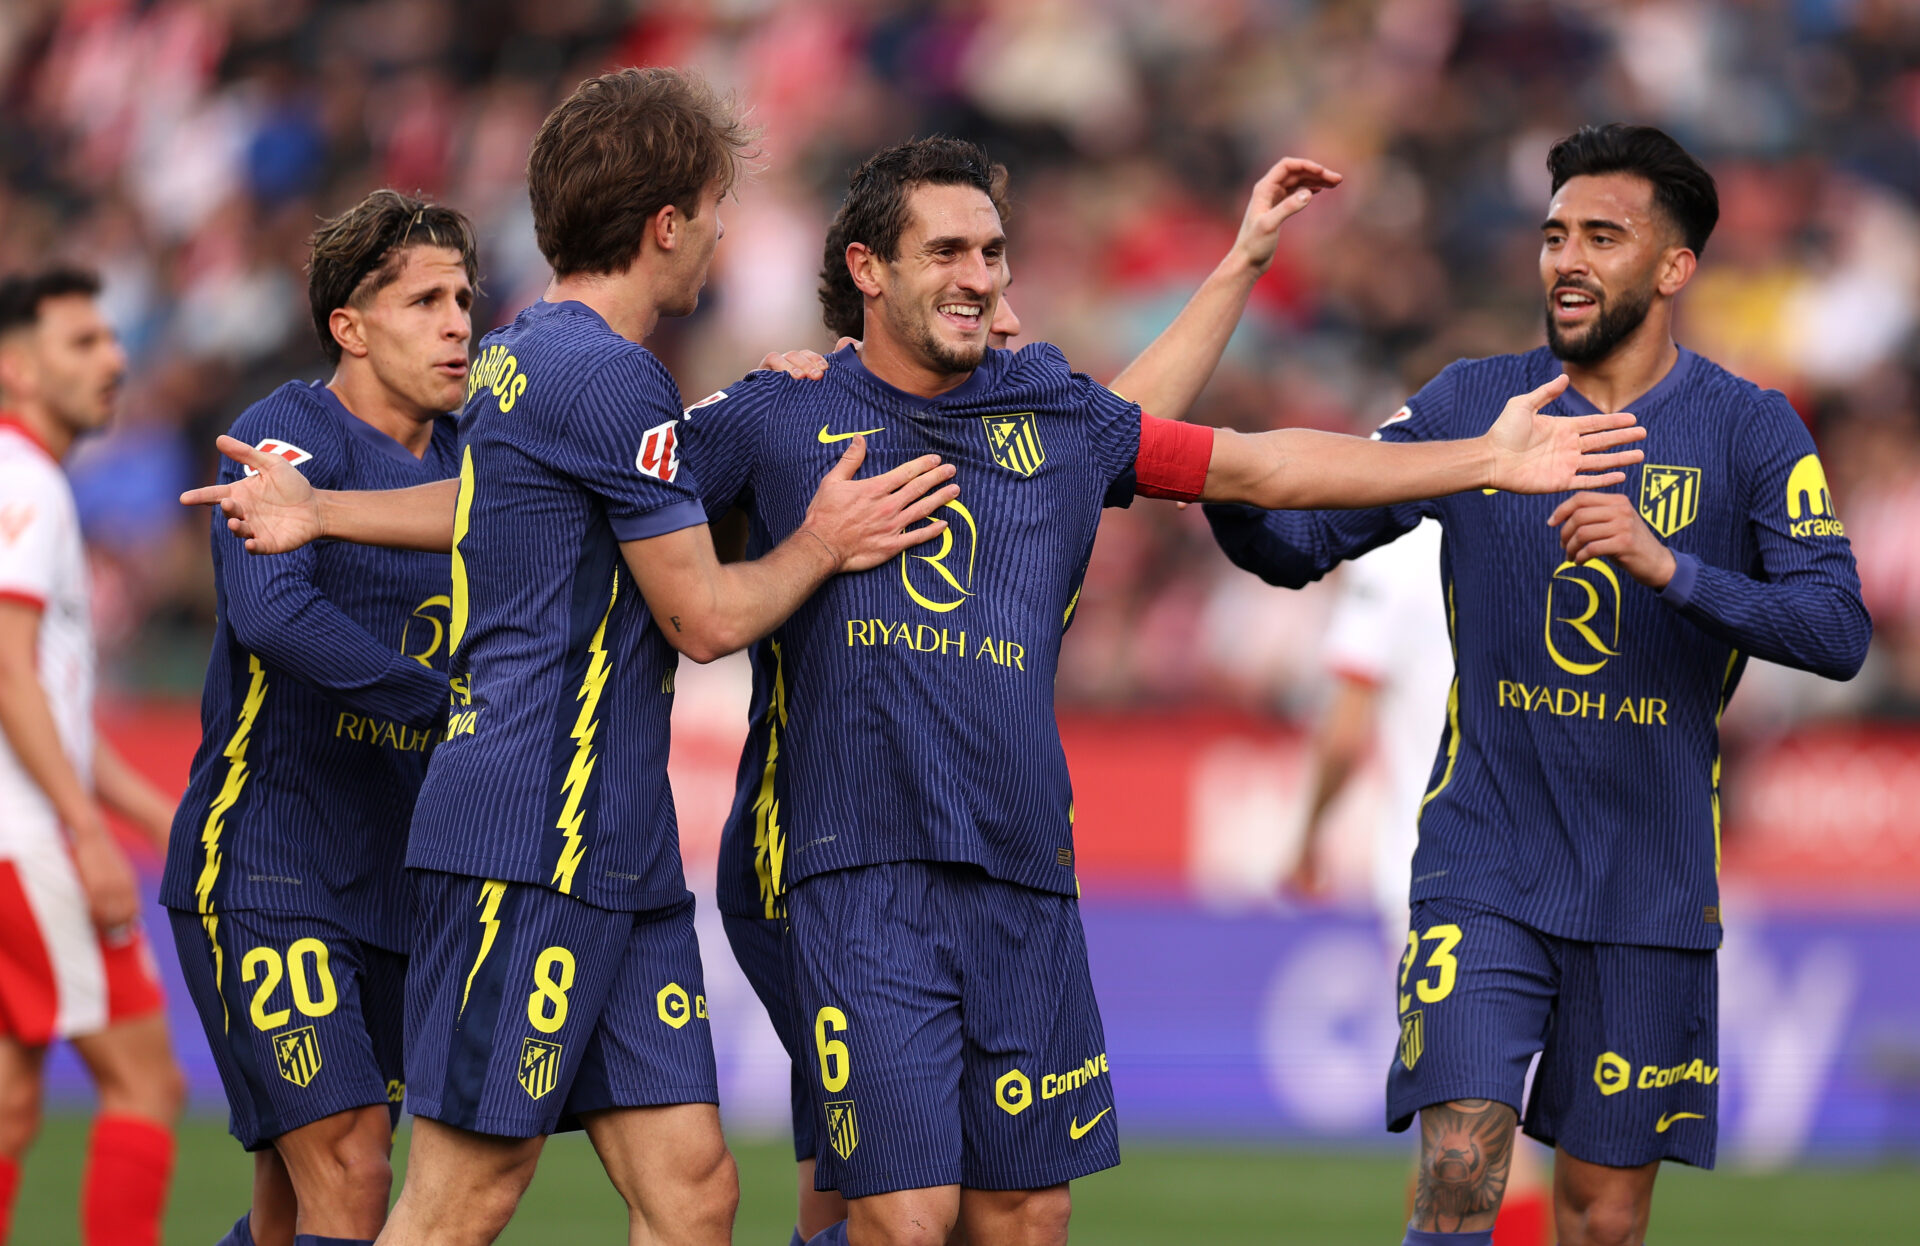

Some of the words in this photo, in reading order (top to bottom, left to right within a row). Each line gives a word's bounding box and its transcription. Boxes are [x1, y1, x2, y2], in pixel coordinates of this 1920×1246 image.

[467, 345, 527, 413] BARRIOS
[847, 618, 966, 658] RIYADH
[975, 636, 1025, 671] AIR
[335, 711, 432, 752] RIYADH
[1498, 680, 1606, 720] RIYADH
[1614, 696, 1668, 726] AIR
[241, 937, 338, 1032] 20
[527, 946, 576, 1033] 8
[1399, 924, 1463, 1013] 23
[815, 1006, 850, 1093] 6
[1636, 1058, 1719, 1089] ComAv
